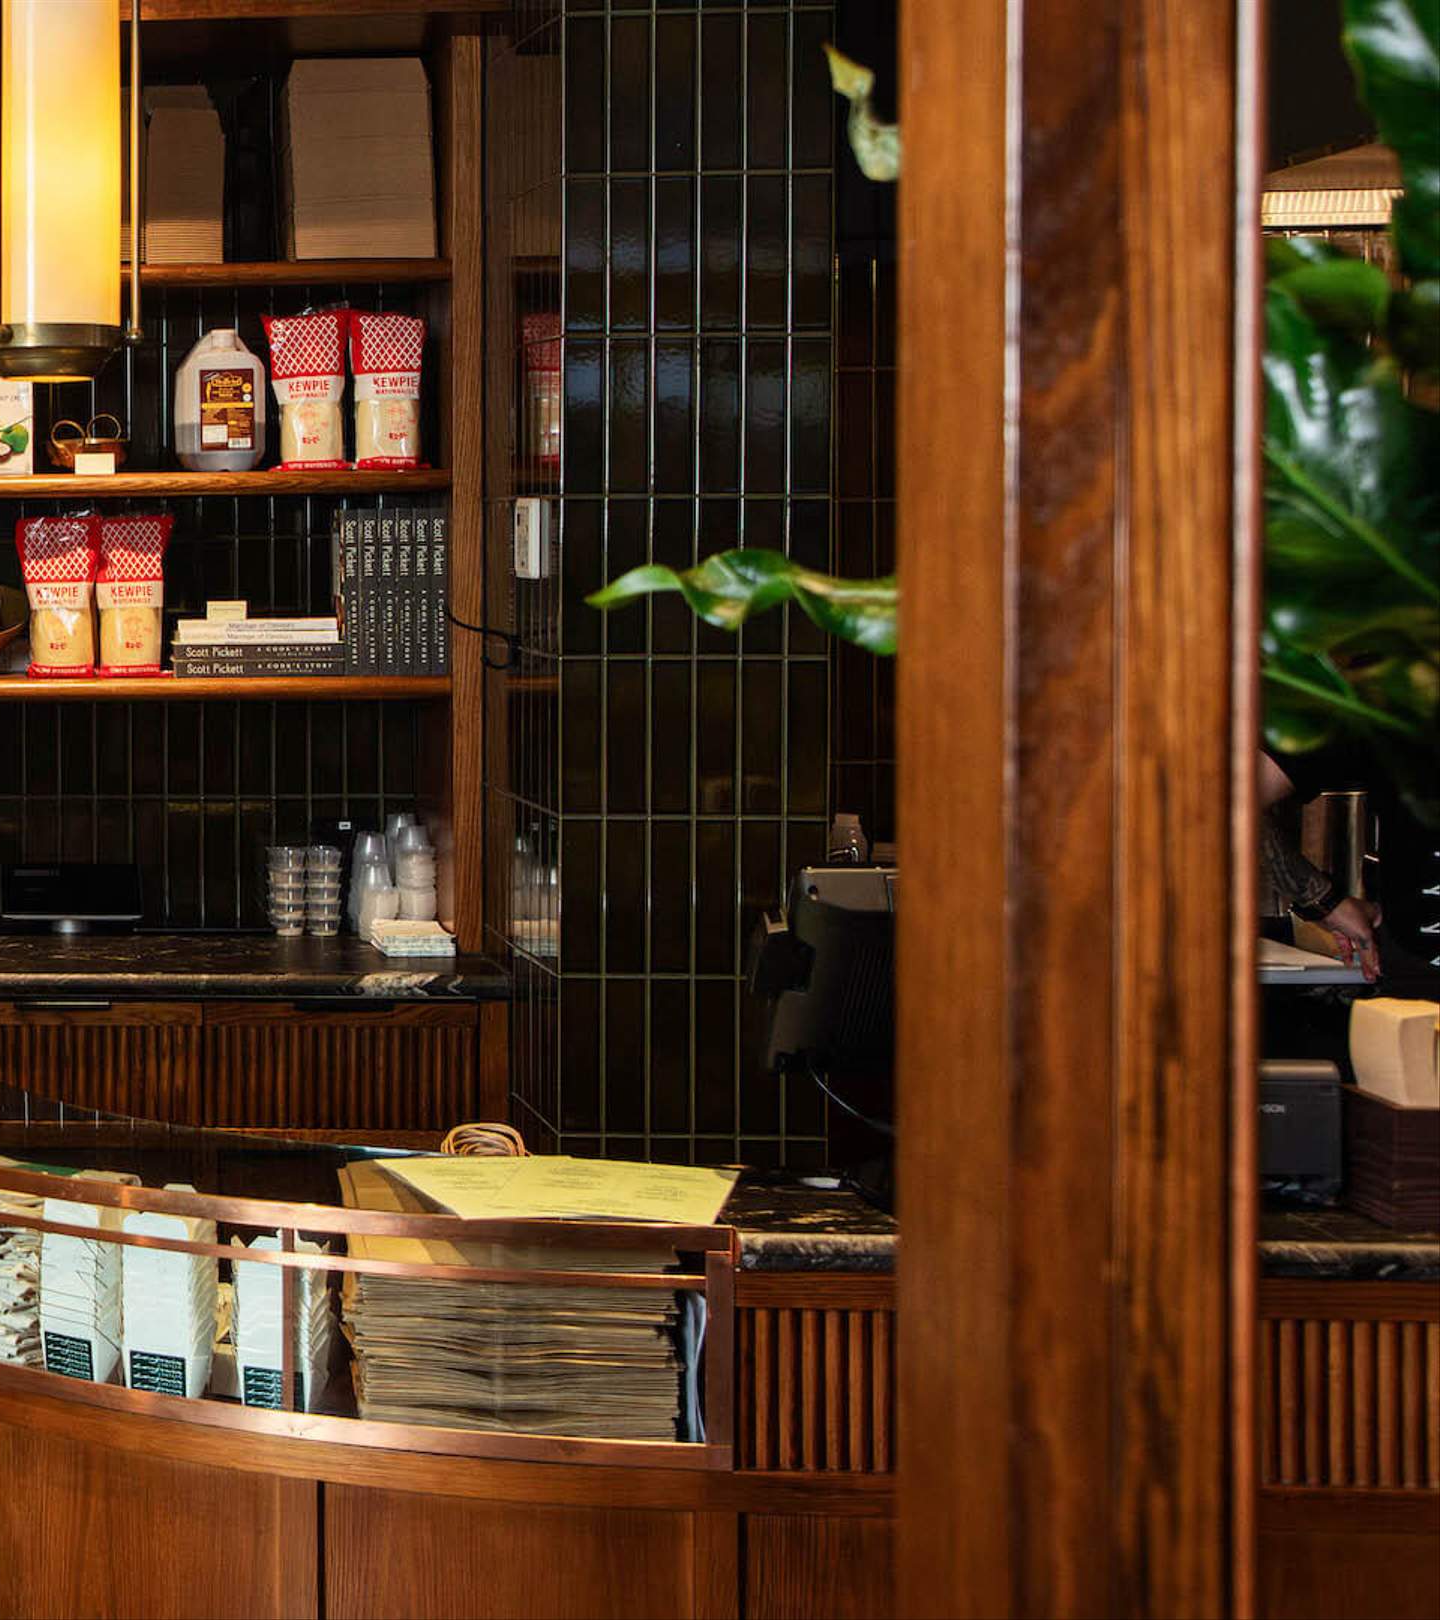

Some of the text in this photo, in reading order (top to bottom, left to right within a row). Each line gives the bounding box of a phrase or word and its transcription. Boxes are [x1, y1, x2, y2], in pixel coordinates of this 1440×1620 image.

[288, 379, 331, 392] KEWPIE
[373, 376, 419, 388] KEWPIE
[345, 520, 357, 543] Scott
[364, 520, 375, 543] Scott
[382, 519, 393, 542] Scott
[400, 519, 411, 542] Scott
[417, 519, 428, 542] Scott
[433, 519, 445, 542] Scott
[345, 546, 357, 577] Pickett
[364, 545, 375, 576] Pickett
[382, 545, 393, 576] Pickett
[400, 545, 411, 576] Pickett
[417, 545, 428, 576] Pickett
[433, 545, 445, 575] Pickett
[110, 585, 154, 598] KEWPIE
[185, 647, 209, 658] Scott
[212, 647, 243, 658] Pickett
[187, 663, 211, 674] Scott
[213, 663, 245, 674] Pickett
